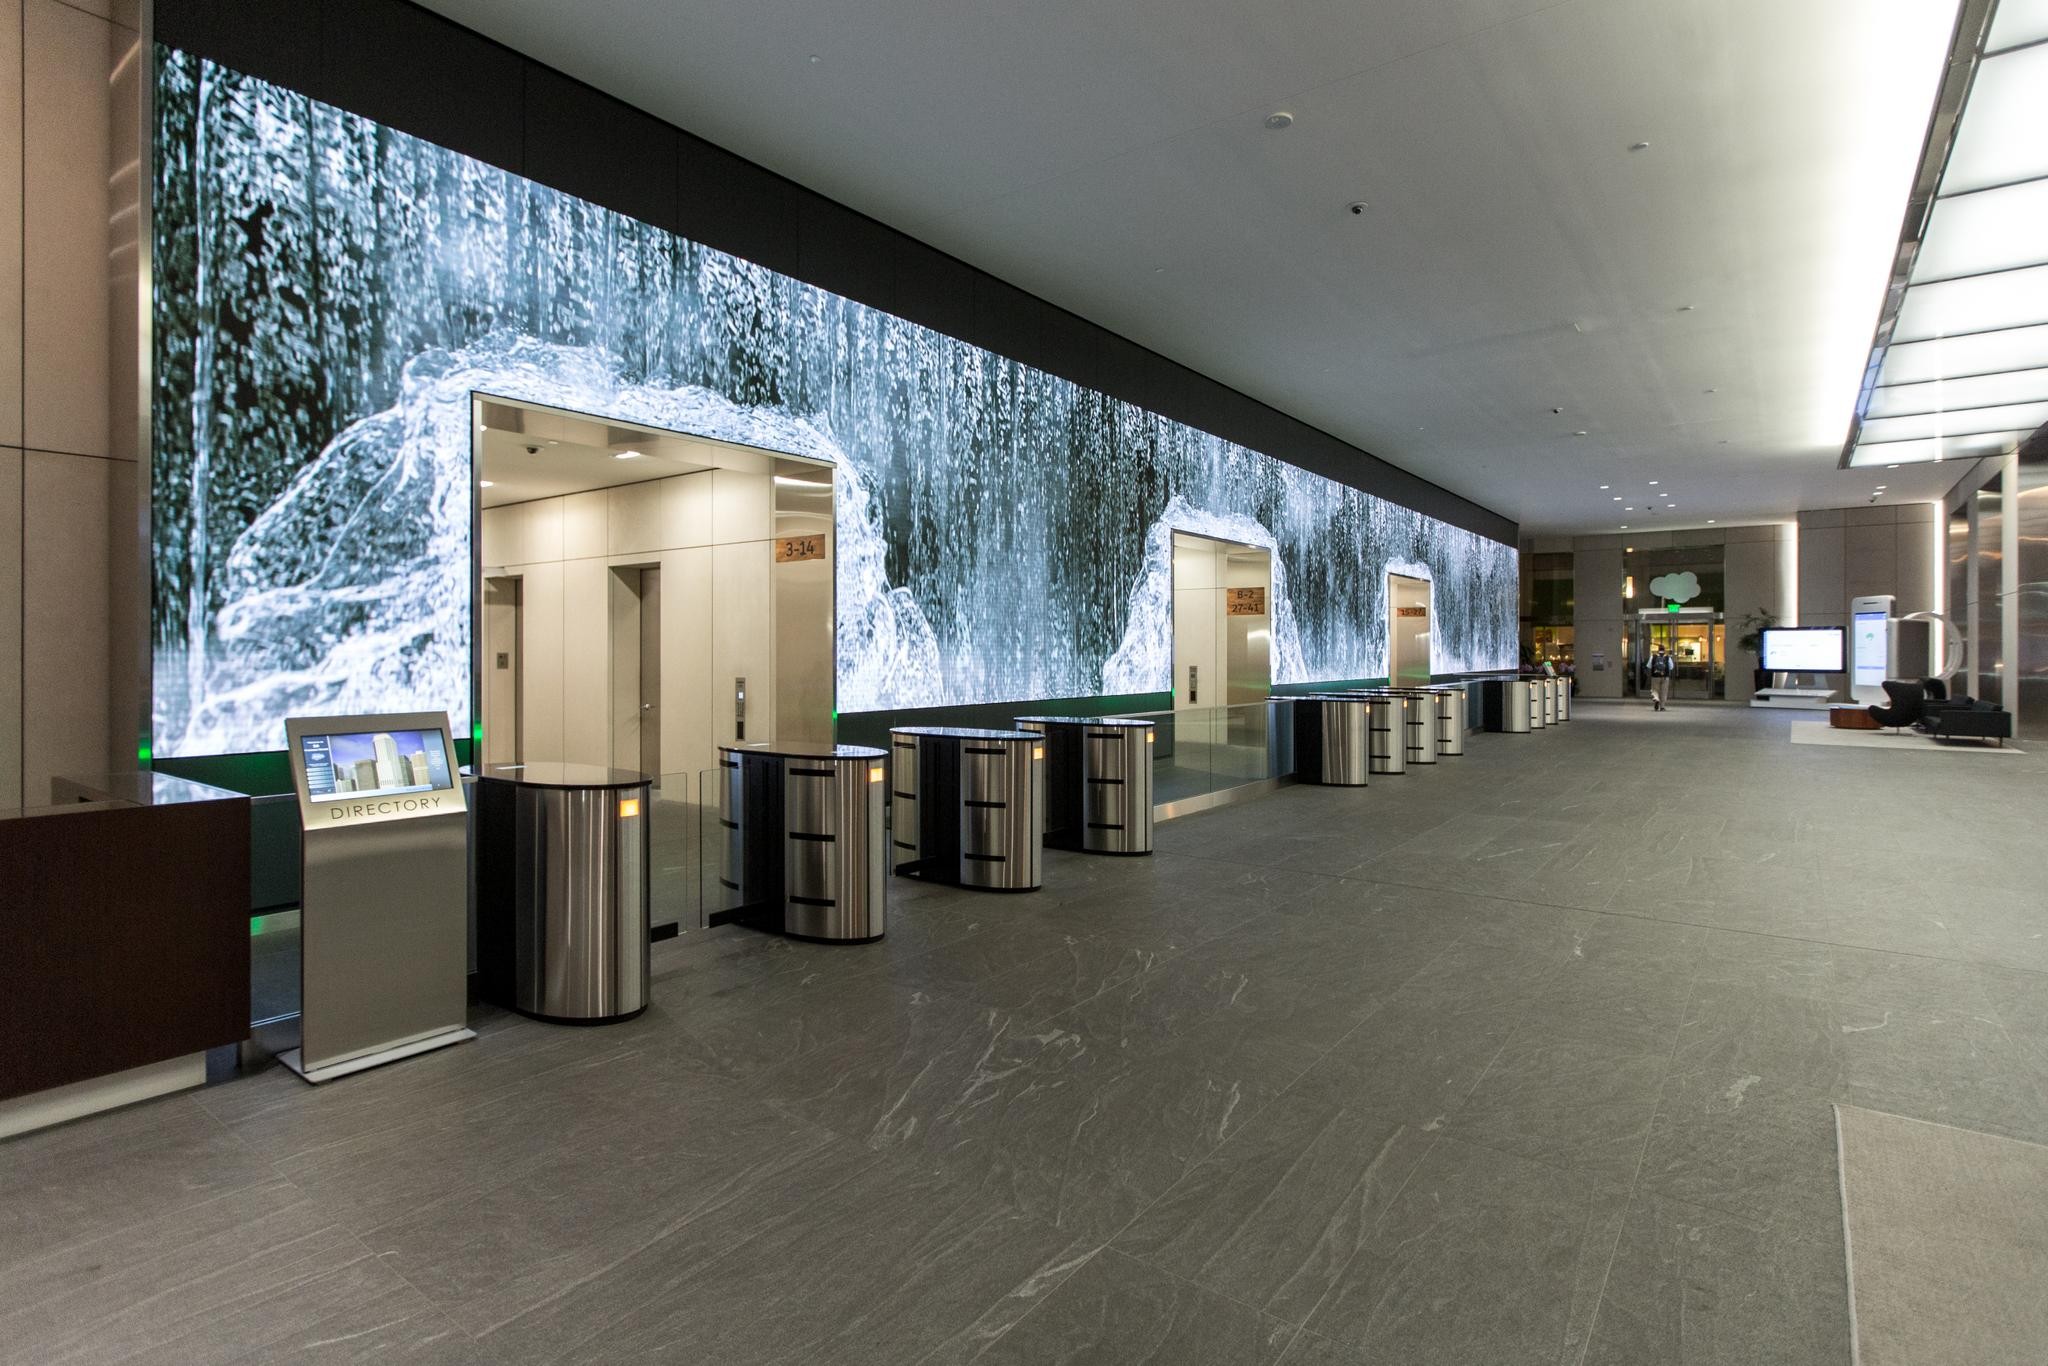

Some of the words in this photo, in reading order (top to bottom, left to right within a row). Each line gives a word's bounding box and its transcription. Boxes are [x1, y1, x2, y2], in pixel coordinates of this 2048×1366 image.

[786, 540, 815, 557] 3-14
[1232, 604, 1258, 613] 27-41
[331, 797, 441, 820] DIRECTORY
